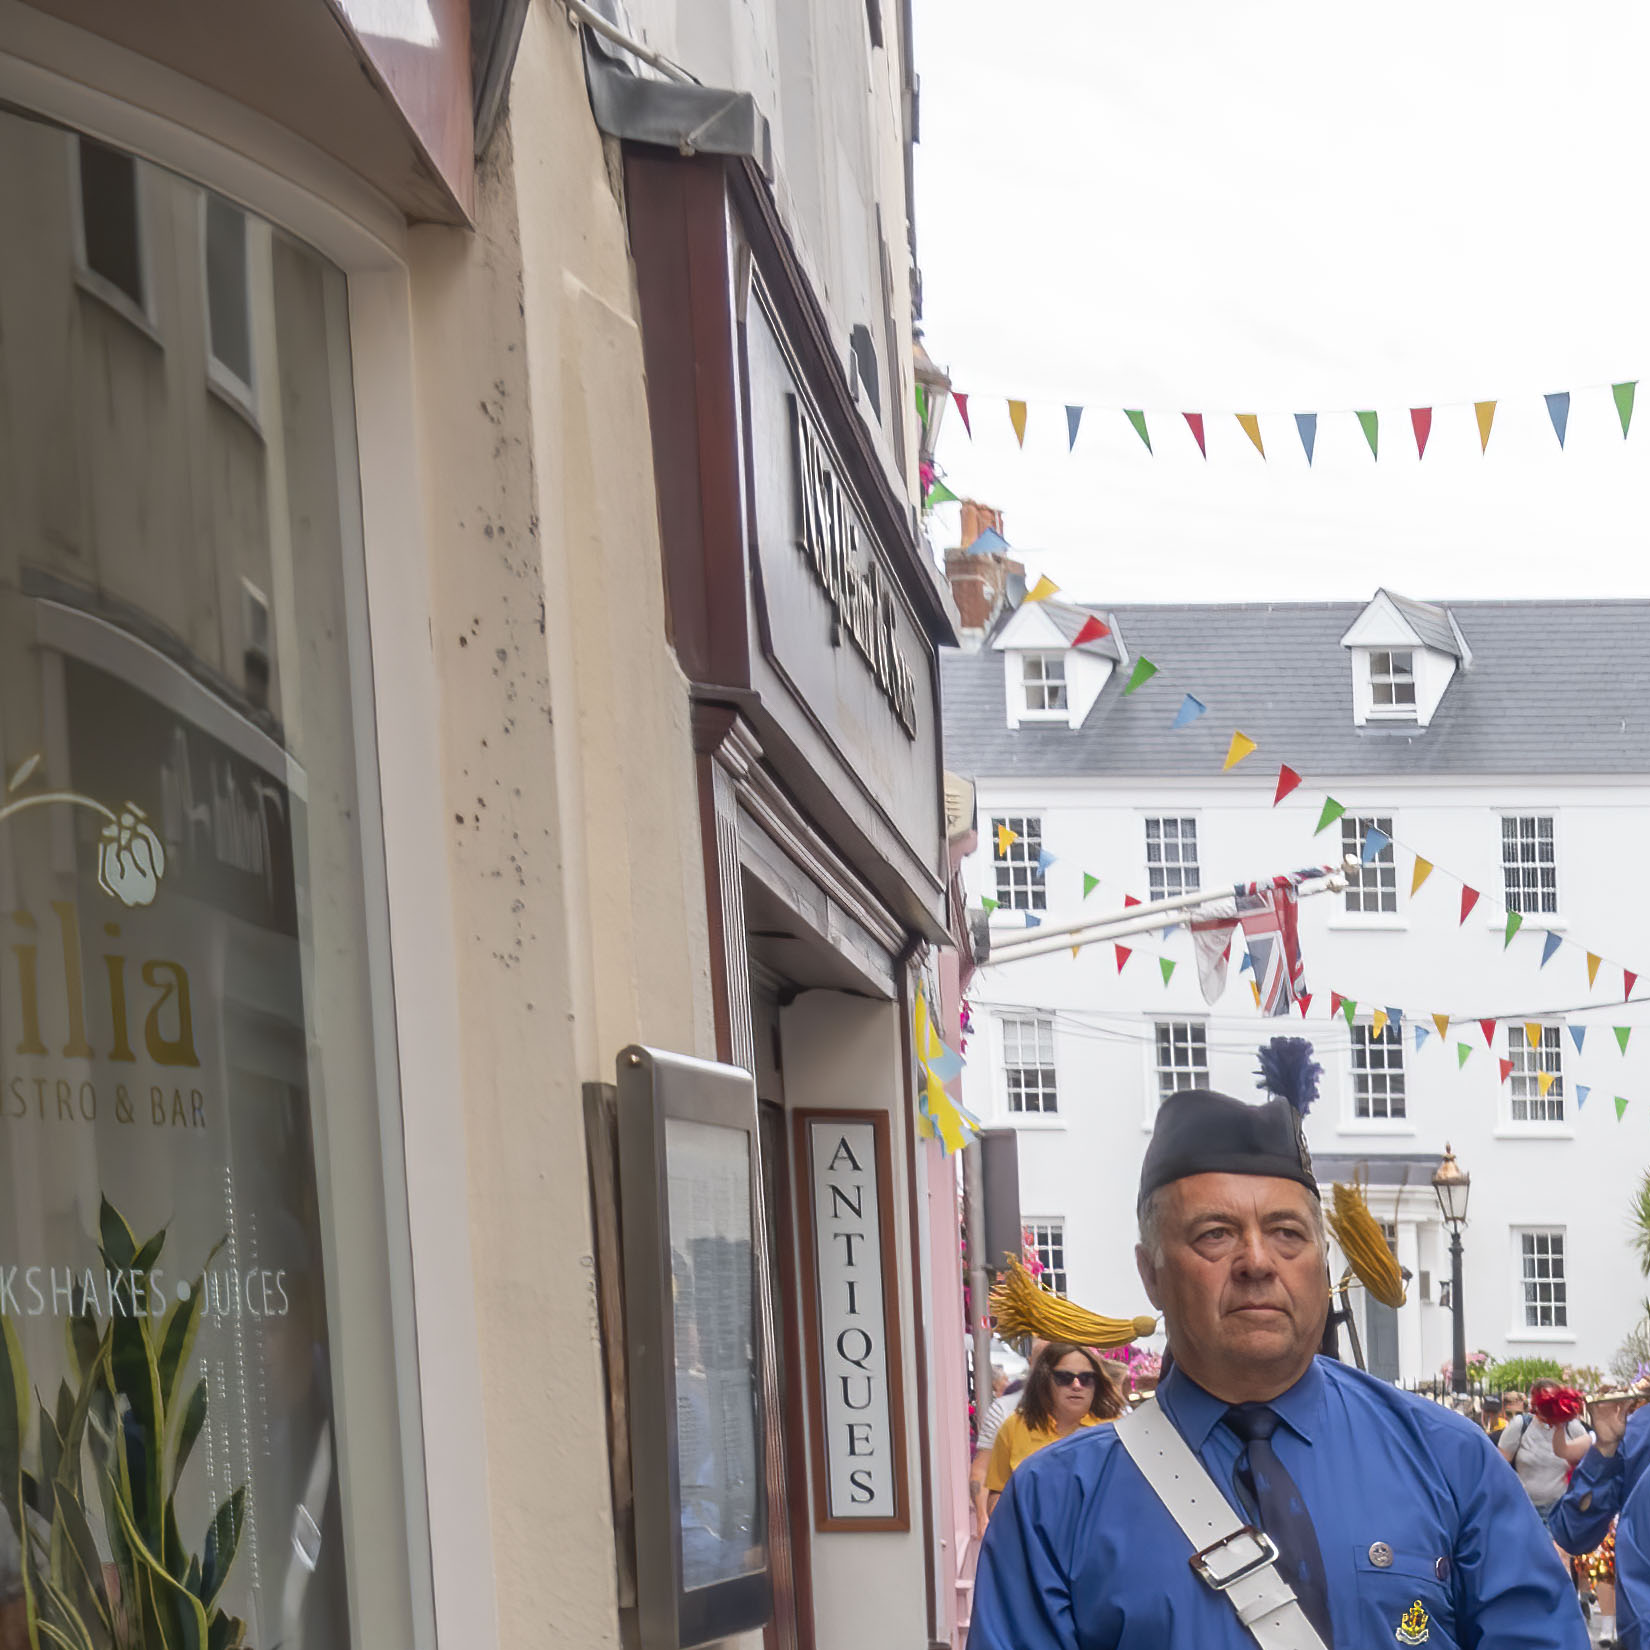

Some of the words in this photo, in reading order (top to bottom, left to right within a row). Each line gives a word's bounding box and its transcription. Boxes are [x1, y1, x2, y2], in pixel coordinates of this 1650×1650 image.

[115, 1083, 135, 1124] &
[150, 1086, 206, 1128] BAR
[201, 1268, 289, 1317] JUICES
[827, 1136, 875, 1504] ANTIQUES
